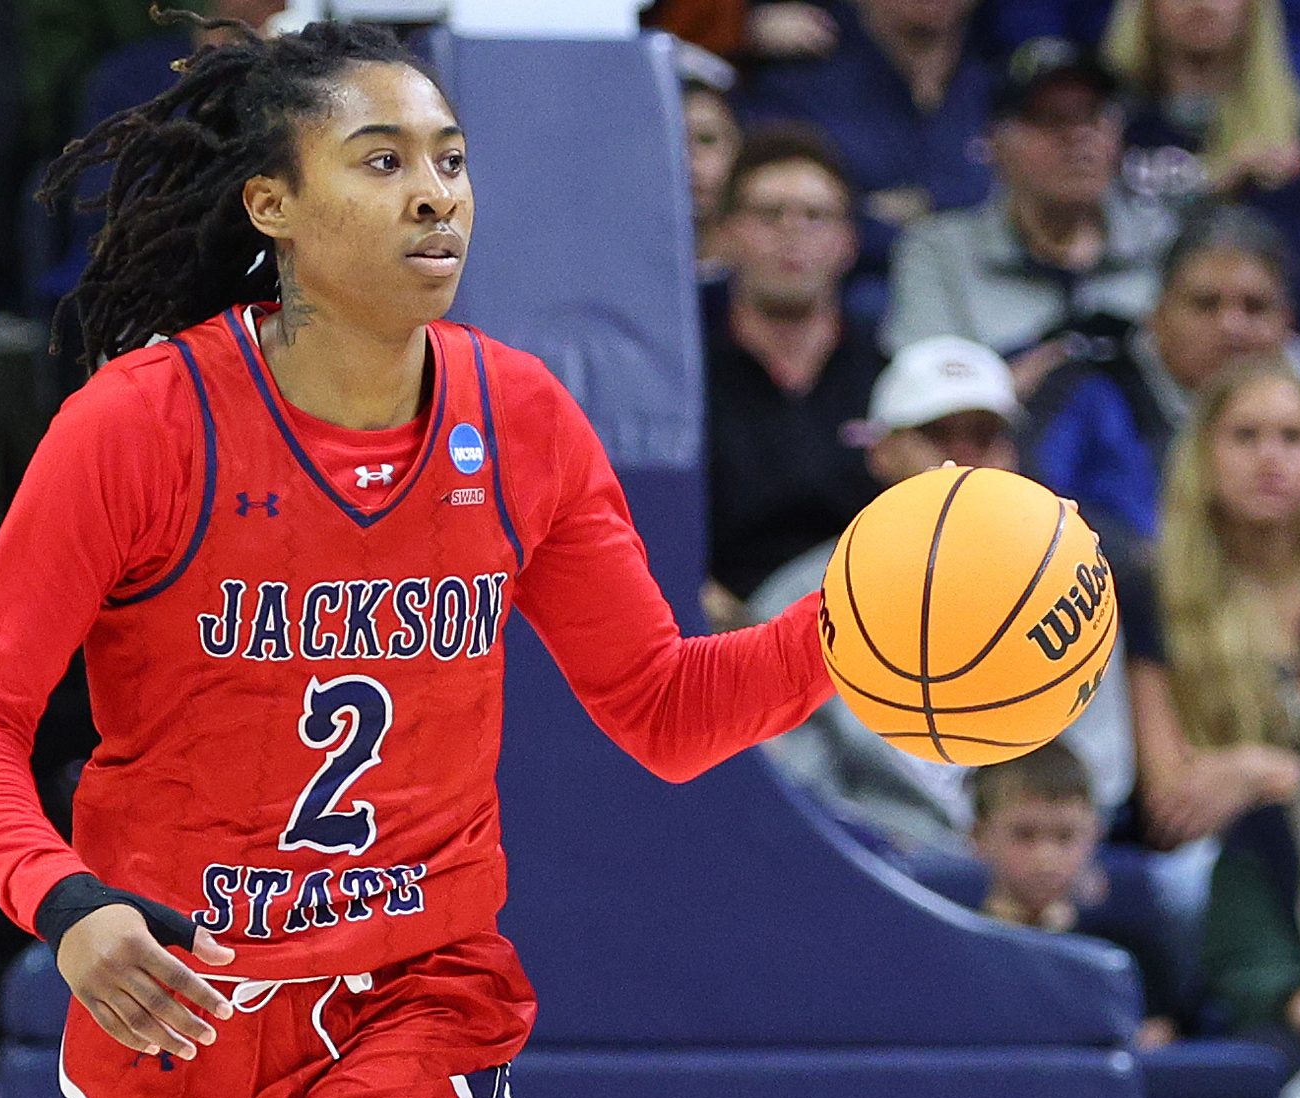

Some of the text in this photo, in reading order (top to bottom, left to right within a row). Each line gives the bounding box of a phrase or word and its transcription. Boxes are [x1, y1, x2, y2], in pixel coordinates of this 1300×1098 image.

[452, 446, 484, 462] NCAA
[452, 489, 485, 505] SWAC
[198, 572, 508, 661] JACKSON
[277, 674, 393, 856] 2
[191, 863, 428, 939] STATE
